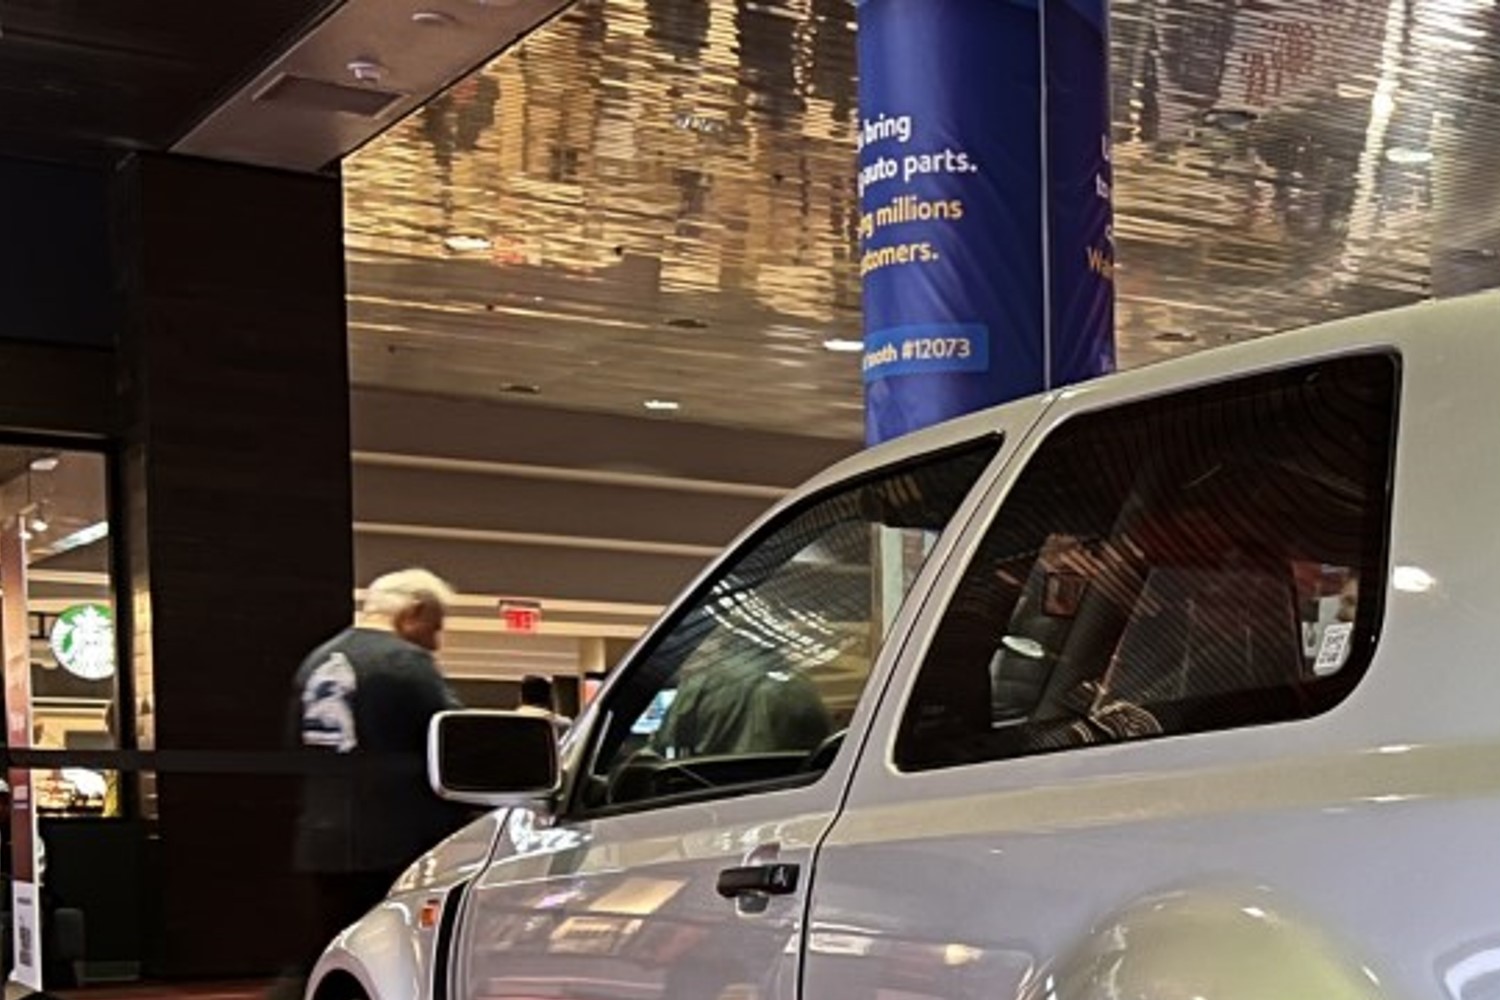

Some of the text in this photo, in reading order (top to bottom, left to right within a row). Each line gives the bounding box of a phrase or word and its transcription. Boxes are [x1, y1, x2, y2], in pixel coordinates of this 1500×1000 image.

[864, 113, 911, 143] bring
[904, 149, 978, 182] parts.
[877, 195, 963, 226] millions
[902, 338, 970, 360] #12073
